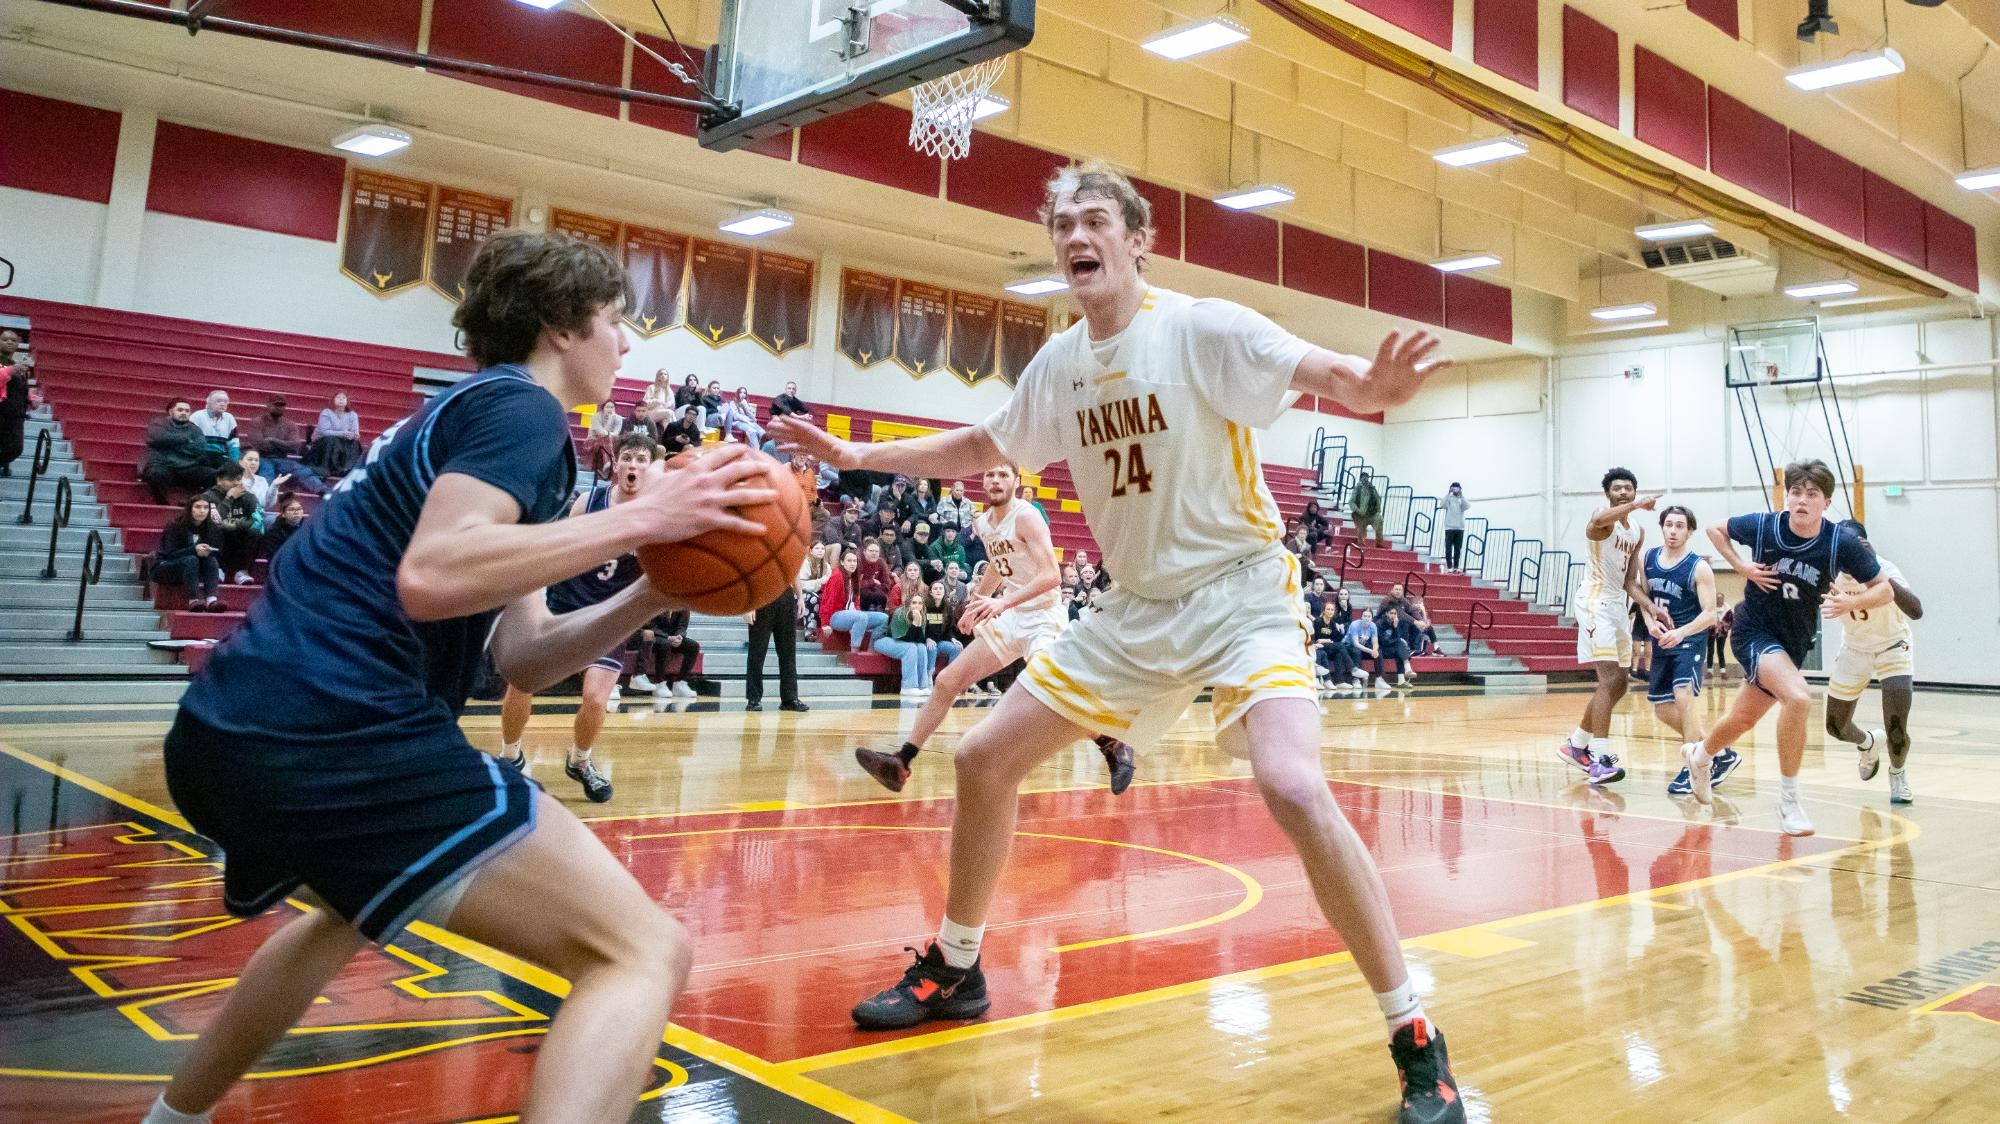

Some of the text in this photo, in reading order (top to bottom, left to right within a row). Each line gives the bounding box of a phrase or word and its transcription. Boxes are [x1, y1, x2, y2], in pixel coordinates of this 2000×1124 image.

[1076, 393, 1169, 447] YAKIMA
[1104, 443, 1152, 497] 24
[1839, 940, 2000, 1011] NORTHWE
